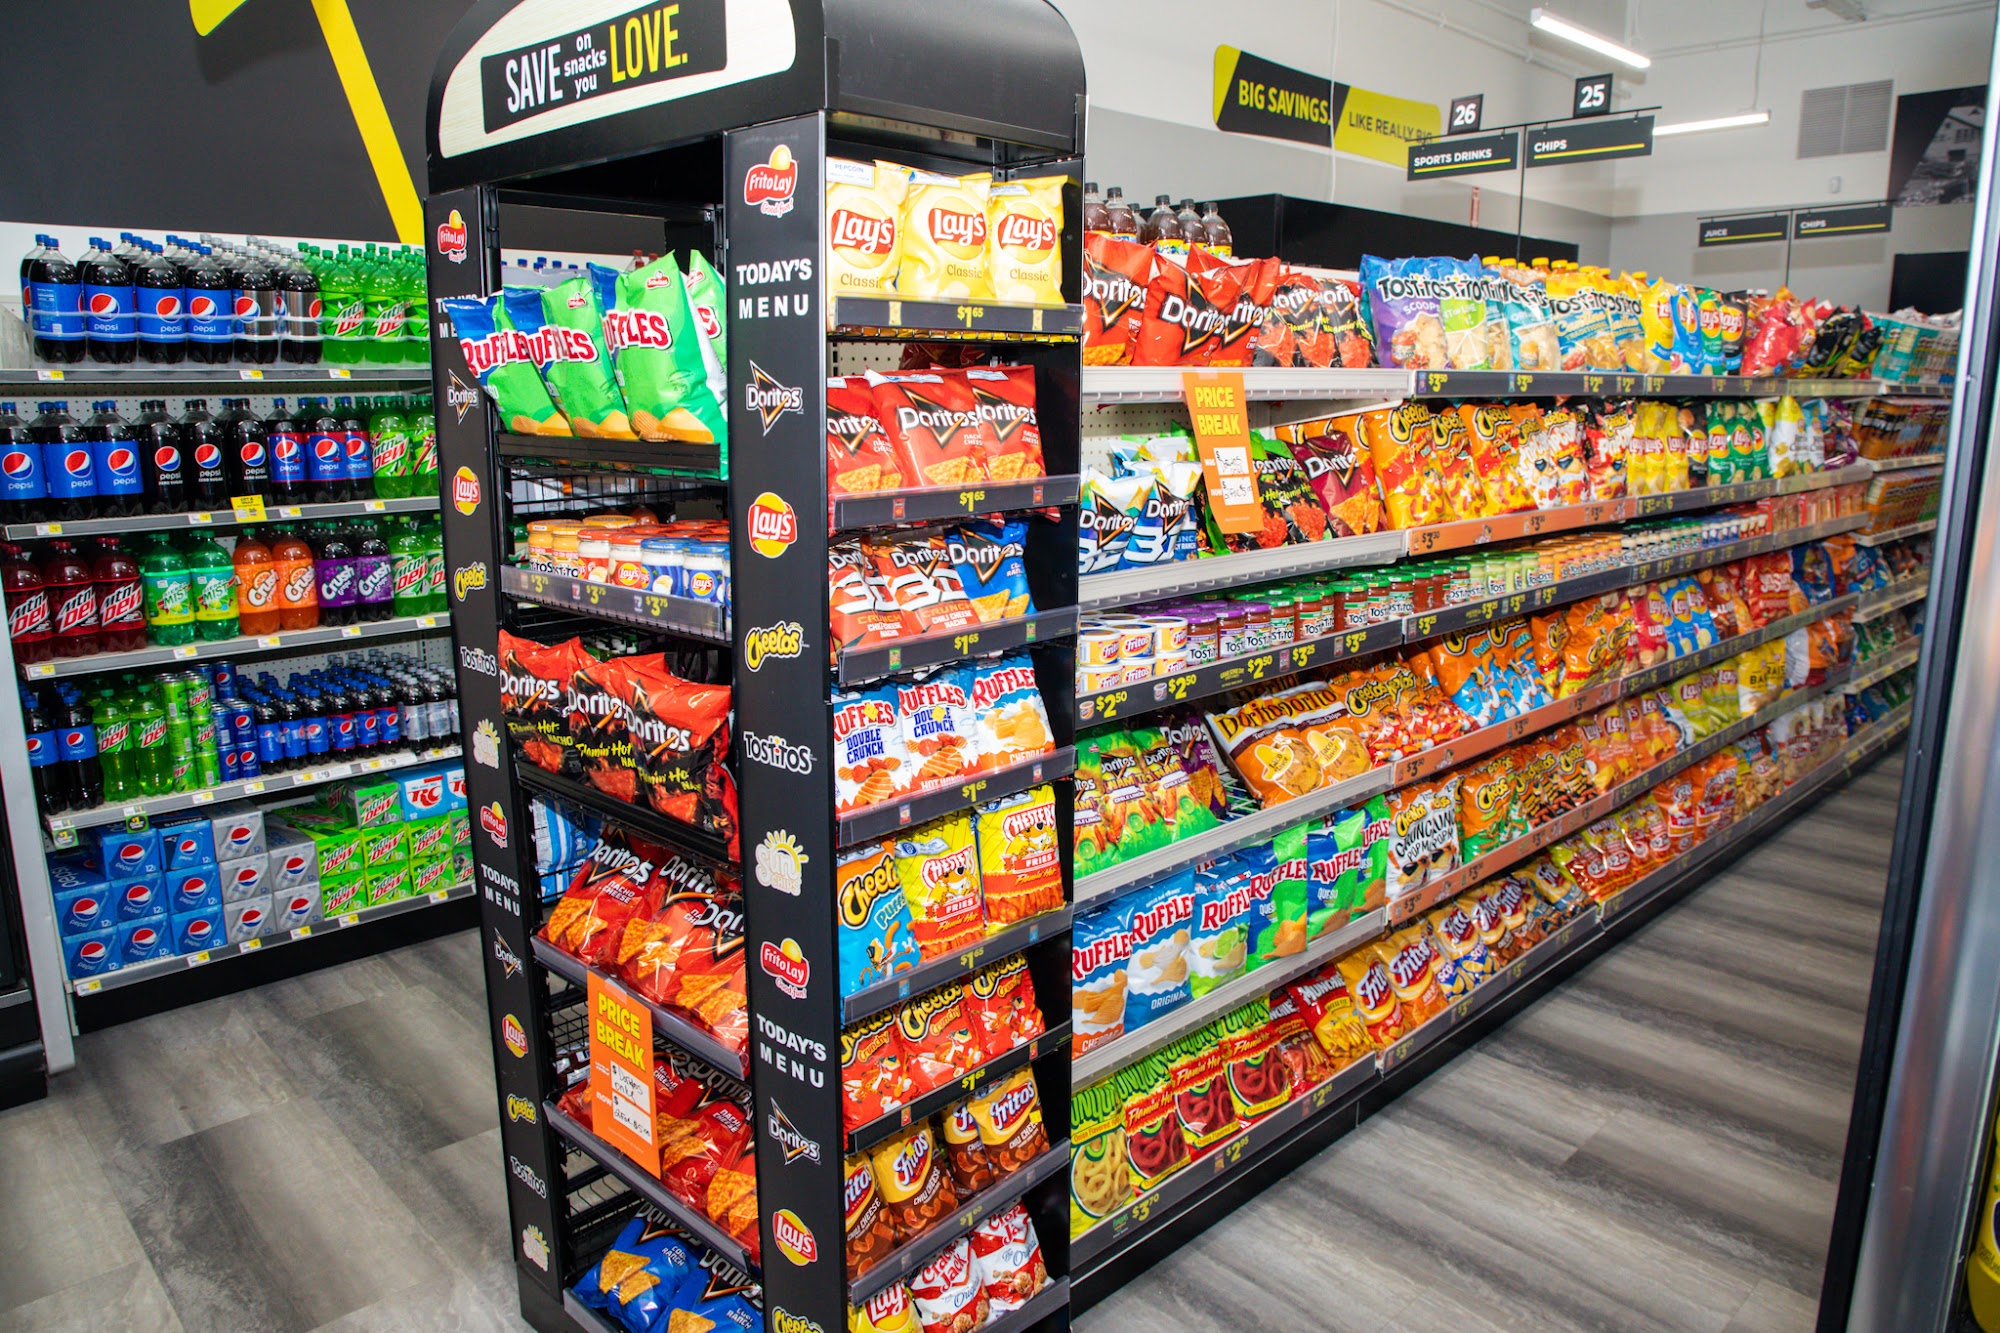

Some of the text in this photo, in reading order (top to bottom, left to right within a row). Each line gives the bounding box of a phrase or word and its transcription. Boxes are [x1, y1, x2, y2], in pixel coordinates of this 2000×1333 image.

[576, 34, 592, 51] on
[609, 3, 688, 85] LOVE.
[563, 48, 607, 77] snacks
[506, 43, 564, 113] SAVE
[574, 74, 597, 99] you
[1238, 79, 1331, 126] BIG SAVINGS.
[1580, 85, 1605, 109] 25
[1453, 103, 1476, 126] 26
[1349, 111, 1414, 142] LIKE REALLY
[1534, 139, 1567, 152] CHIPS
[1414, 148, 1492, 167] SPORTS DRINKS
[832, 210, 893, 254] Lay's
[933, 208, 985, 245] Lay's
[1001, 214, 1055, 250] Lay's
[1705, 229, 1727, 237] JUICE
[1801, 220, 1826, 228] CHIPS
[736, 259, 812, 285] TODAY'S
[947, 264, 983, 279] Classic
[1010, 268, 1049, 282] Classic
[739, 294, 808, 319] MENU
[94, 323, 119, 333] pepsi
[160, 324, 182, 333] pepsi
[193, 324, 216, 334] pepsi
[449, 388, 478, 404] Doritos
[747, 386, 802, 411] Doritos
[1195, 386, 1235, 408] PRICE
[1198, 413, 1242, 437] BREAK
[113, 476, 137, 487] pepsi
[159, 472, 181, 482] pepsi
[199, 469, 221, 479] pepsi
[243, 468, 265, 477] pepsi
[8, 480, 34, 492] pepsi
[70, 479, 94, 490] pepsi
[752, 508, 792, 537] Lay's
[893, 548, 950, 569] Doritos
[949, 543, 1024, 565] Doritos
[249, 570, 279, 606] Crush
[286, 566, 316, 602] Crush
[322, 565, 355, 600] Crush
[359, 563, 391, 597] Crush
[455, 566, 485, 600] Cheetos
[692, 576, 713, 590] Lay's
[932, 610, 973, 624] CHILI CHEESE
[945, 618, 968, 629] NACHO
[747, 625, 802, 670] Cheetos
[1125, 635, 1150, 652] Fritos
[1325, 712, 1341, 721] Chips
[548, 735, 574, 746] NACHO
[626, 706, 691, 752] Doritos
[846, 728, 881, 750] DOUBLE
[914, 720, 955, 738] CRUNCH
[611, 742, 633, 757] Hot
[847, 741, 884, 764] CRUNCH
[921, 779, 939, 791] HOT
[590, 838, 654, 886] Doritos
[1026, 853, 1053, 868] FRIES
[481, 863, 519, 896] TODAY'S
[485, 886, 520, 916] MENU
[602, 886, 631, 904] CHEESE
[1318, 886, 1338, 900] QUESO
[945, 899, 974, 914] FRIES
[494, 944, 522, 970] Doritos
[598, 992, 640, 1040] PRICE
[596, 1019, 645, 1071] BREAK
[756, 1013, 826, 1061] TODAY'S
[760, 1042, 824, 1088] MENU
[508, 1095, 536, 1124] Cheetos
[991, 1081, 1035, 1125] Fritos
[769, 1117, 820, 1158] Doritos
[914, 1166, 940, 1205] CHILI CHEESE
[860, 1198, 880, 1228] CHEESE
[778, 1216, 814, 1254] Lay's
[662, 1248, 685, 1267] RANCH
[940, 1255, 967, 1293] Jack
[726, 1309, 751, 1329] RANCH
